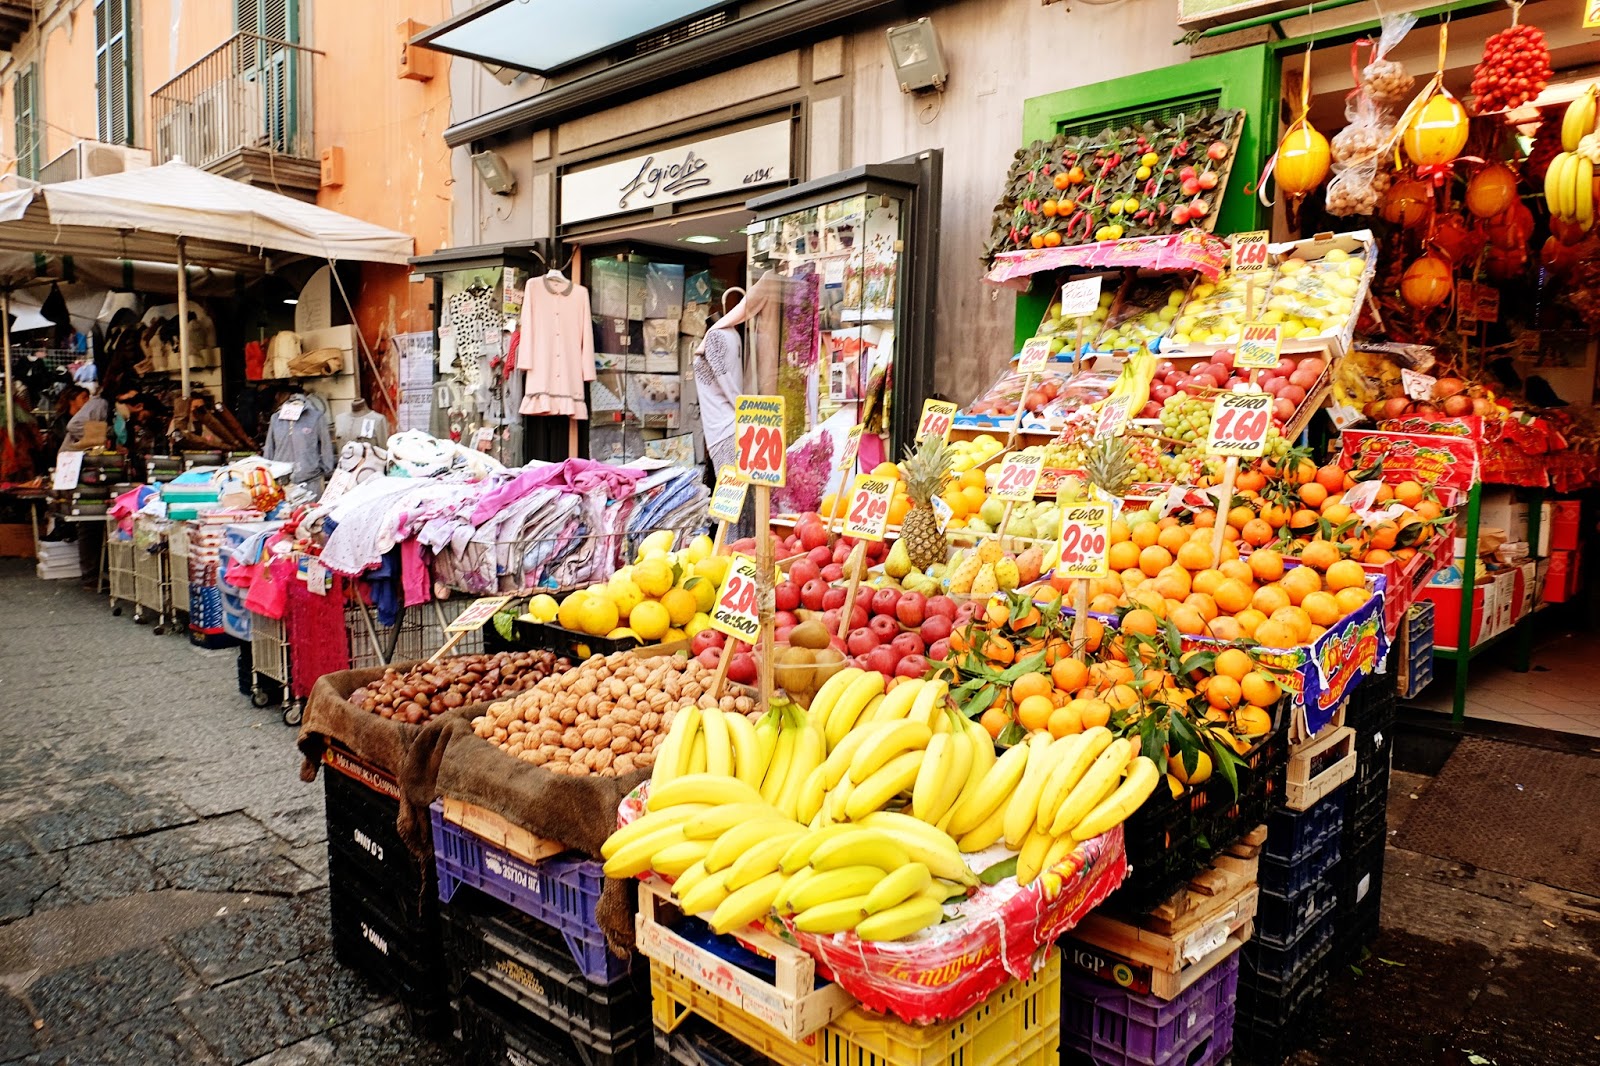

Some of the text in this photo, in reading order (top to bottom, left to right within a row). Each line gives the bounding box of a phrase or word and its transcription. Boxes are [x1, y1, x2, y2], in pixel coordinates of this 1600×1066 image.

[1237, 236, 1263, 245] EURO
[1244, 327, 1277, 341] UVA
[1239, 341, 1277, 365] MOSCATO
[738, 400, 781, 413] BANANE
[927, 404, 953, 415] EURO
[1223, 397, 1267, 410] EURO
[738, 425, 783, 474] 1,20
[1213, 441, 1260, 450] CHILO
[1008, 454, 1041, 465] EURO
[752, 470, 781, 483] CHILO
[861, 480, 889, 495] EURO
[1067, 508, 1105, 521] EURO
[852, 524, 876, 534] CHILO
[1068, 563, 1098, 572] CHILO
[1073, 948, 1105, 972] IGP
[884, 960, 911, 983] La
